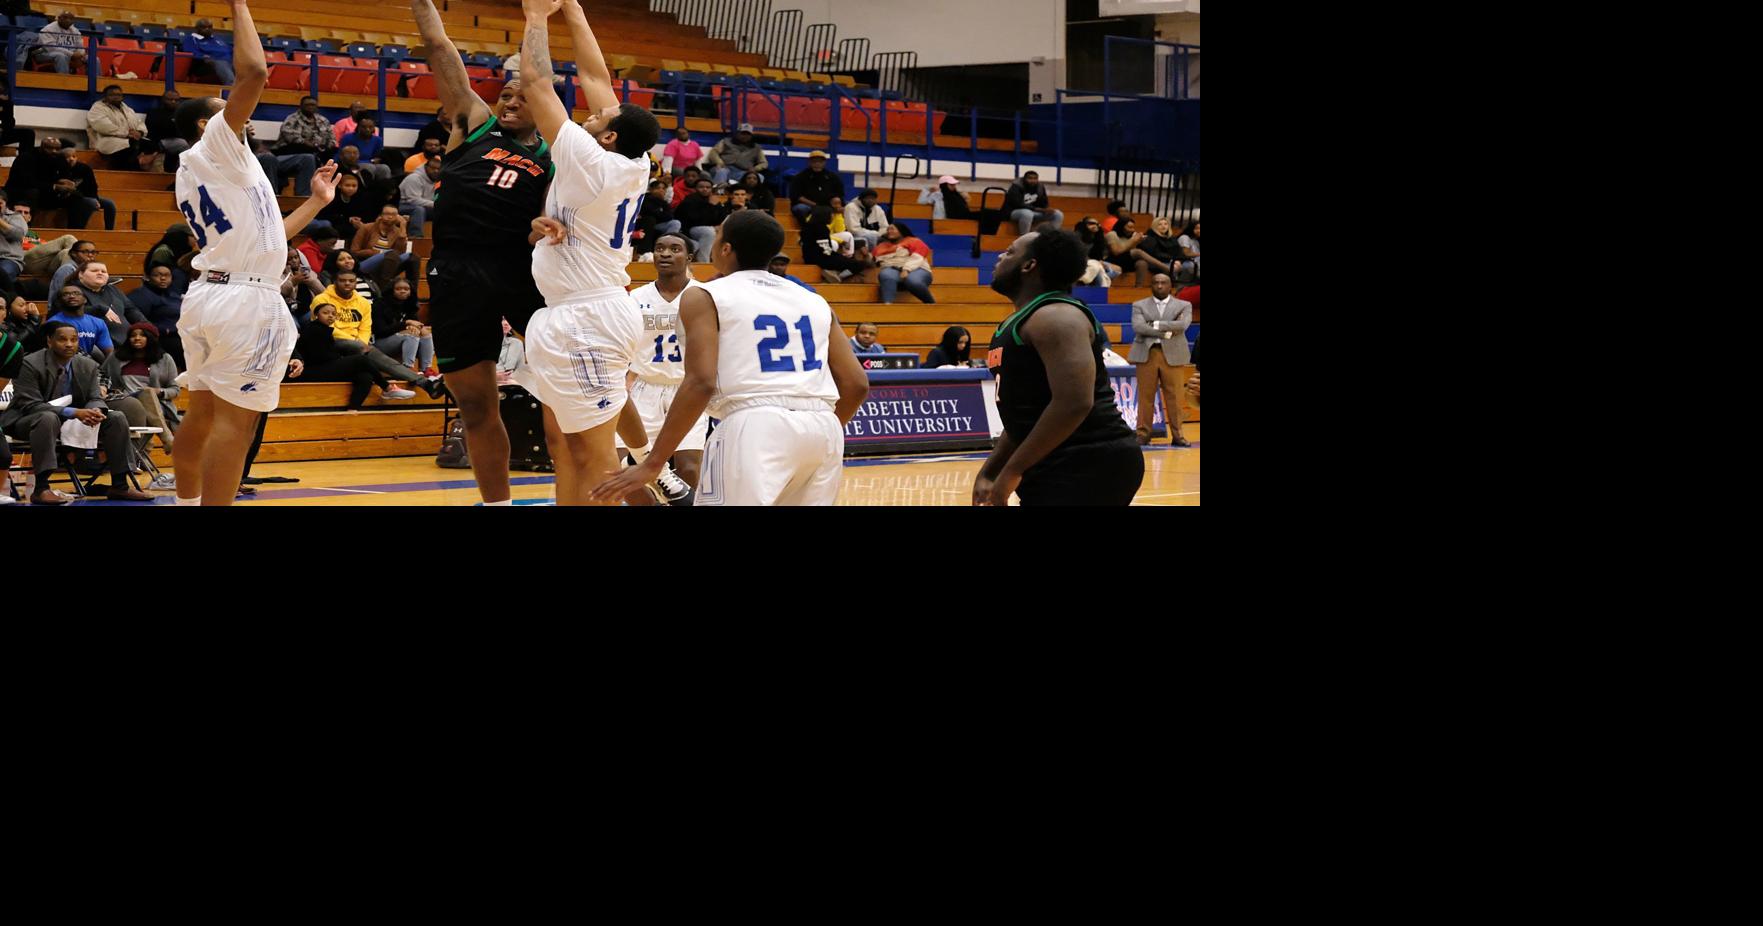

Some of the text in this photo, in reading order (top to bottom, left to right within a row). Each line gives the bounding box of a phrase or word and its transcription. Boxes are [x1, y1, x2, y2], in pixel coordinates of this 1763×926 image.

[487, 165, 519, 189] 10
[652, 334, 682, 362] 13
[753, 314, 822, 372] 21
[870, 360, 883, 368] POSS
[867, 387, 929, 399] COME TO
[856, 399, 959, 417] ABETH CITY
[845, 416, 973, 436] TE UNIVERSITY
